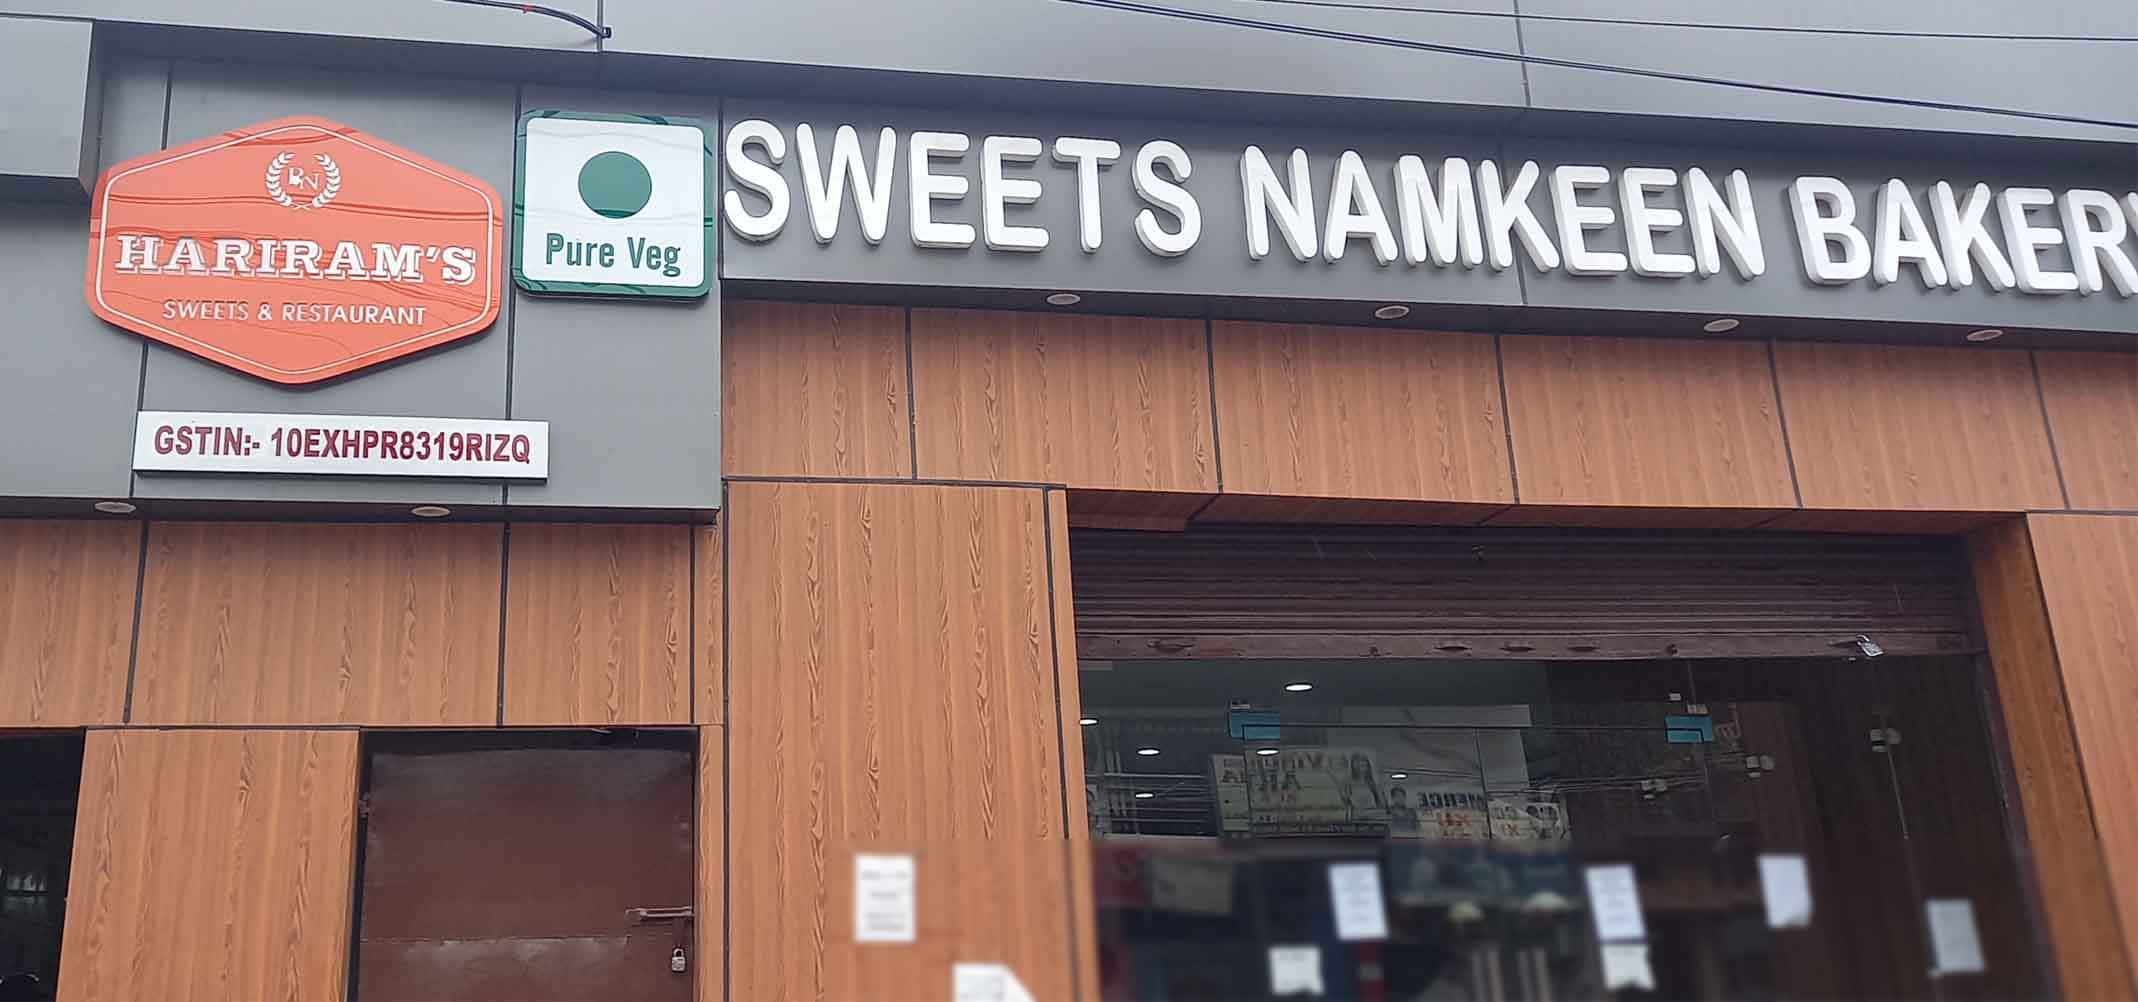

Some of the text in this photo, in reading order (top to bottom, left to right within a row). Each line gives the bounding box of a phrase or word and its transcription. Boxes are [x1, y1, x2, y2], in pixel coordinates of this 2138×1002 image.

[724, 119, 2138, 298] SWEETS NAMKEEN BAKER
[115, 234, 478, 286] HARIRAM'S
[545, 232, 681, 278] Pure Veg
[162, 299, 427, 326] SWEETS & RESTAURANT
[154, 425, 260, 457] GSTIN:-
